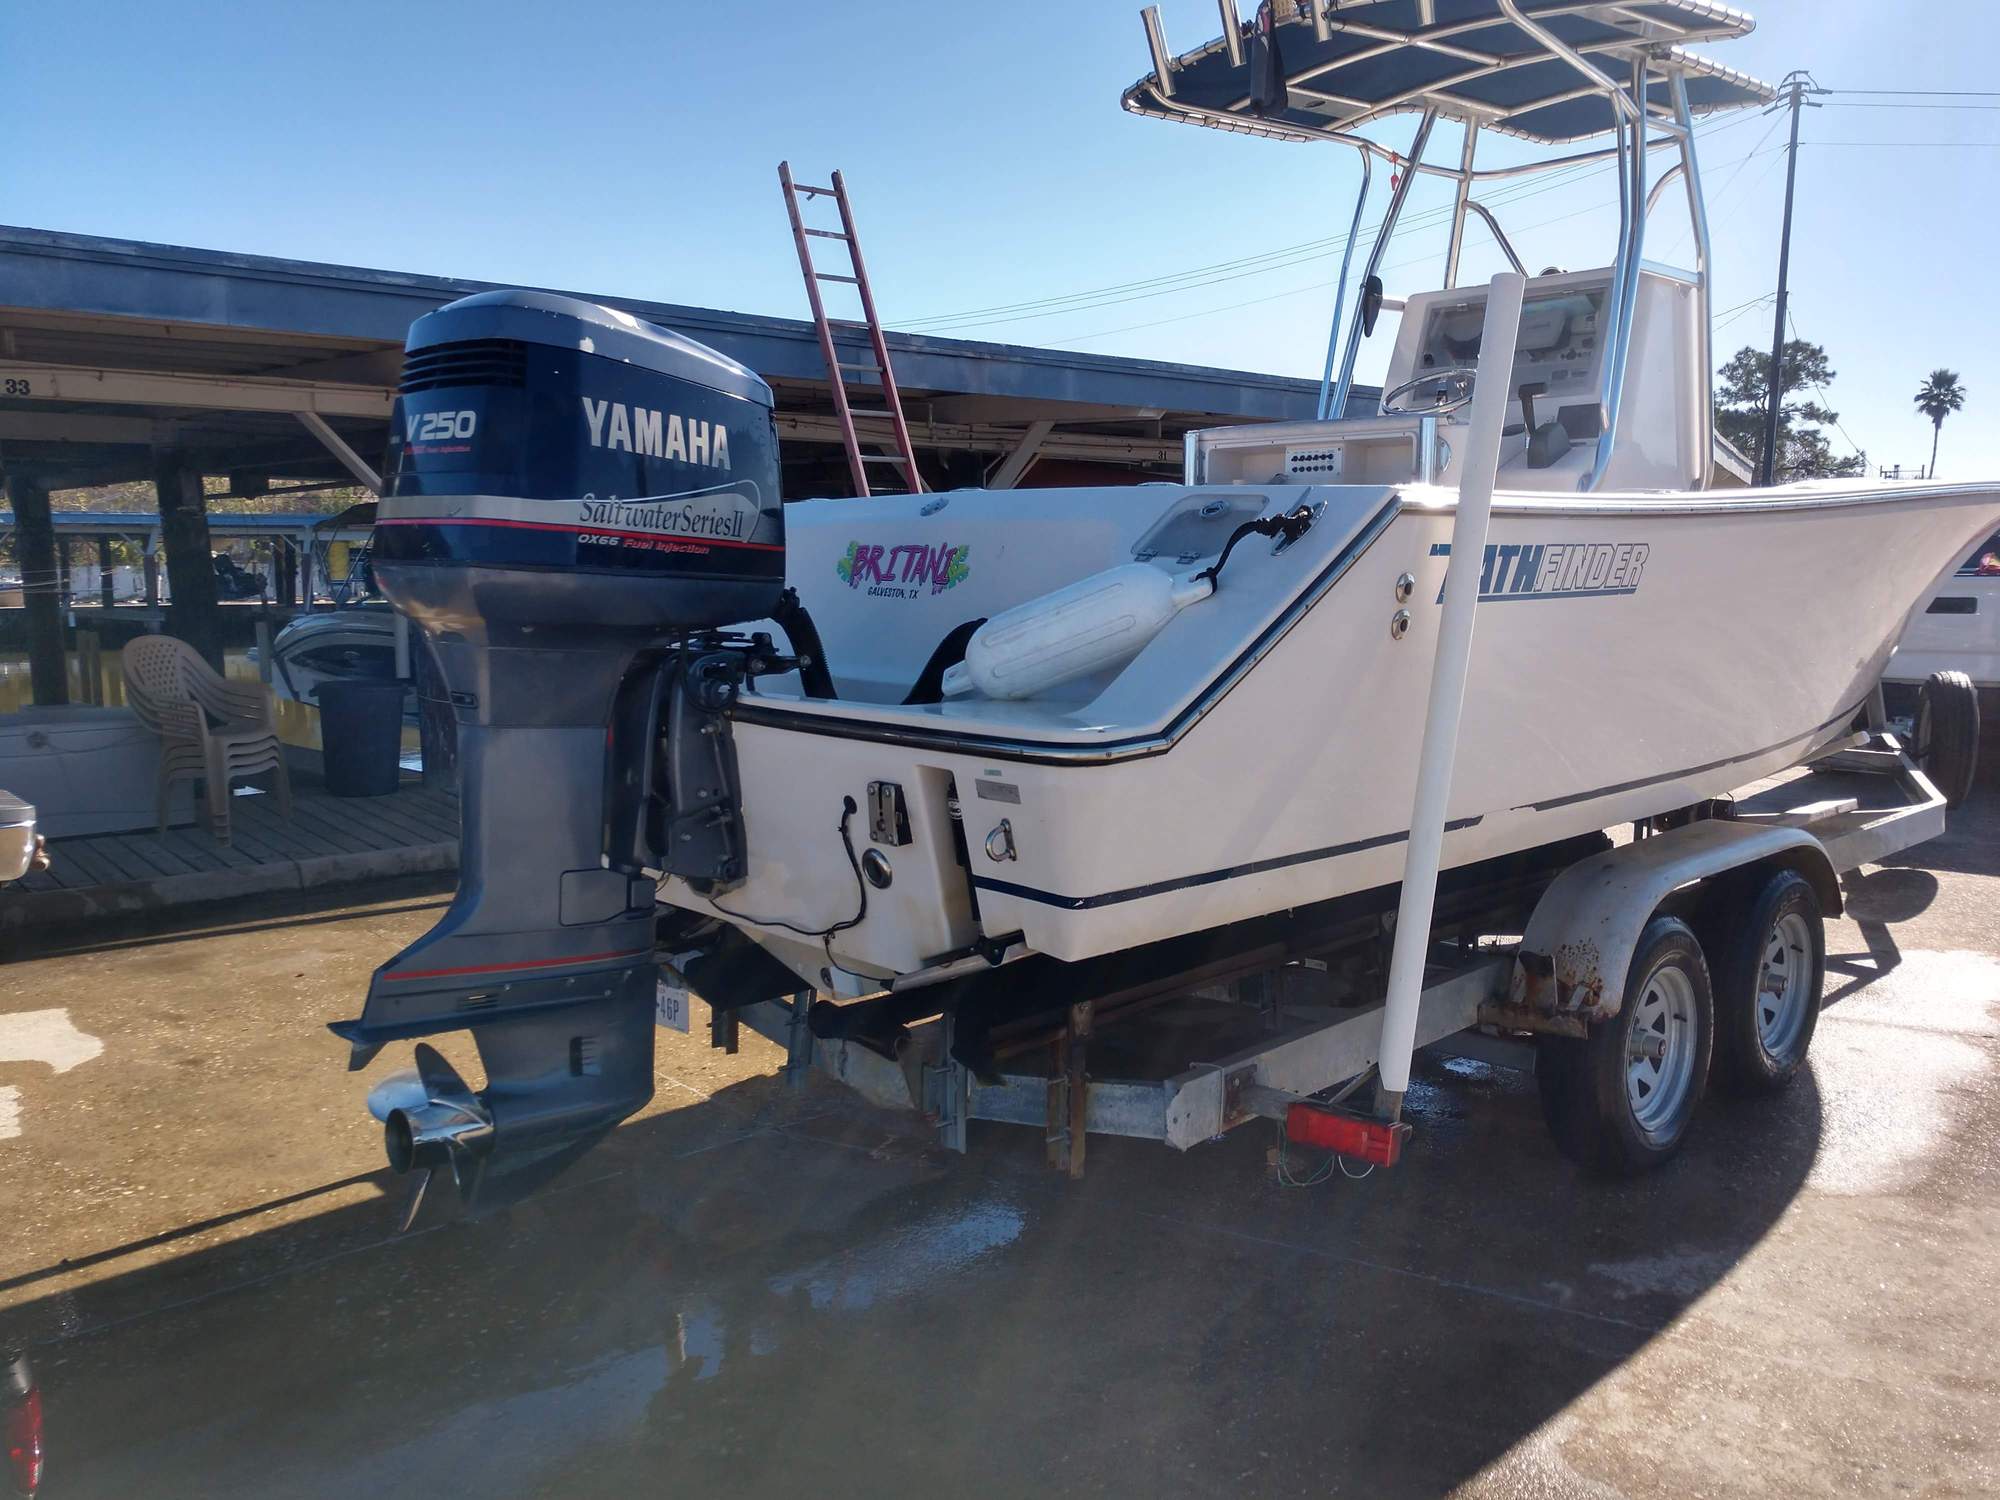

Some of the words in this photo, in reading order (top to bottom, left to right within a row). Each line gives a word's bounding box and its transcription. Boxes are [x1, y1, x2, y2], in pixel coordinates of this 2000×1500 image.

[5, 379, 31, 396] 33
[582, 397, 731, 471] YAMAHA
[909, 589, 919, 600] TX
